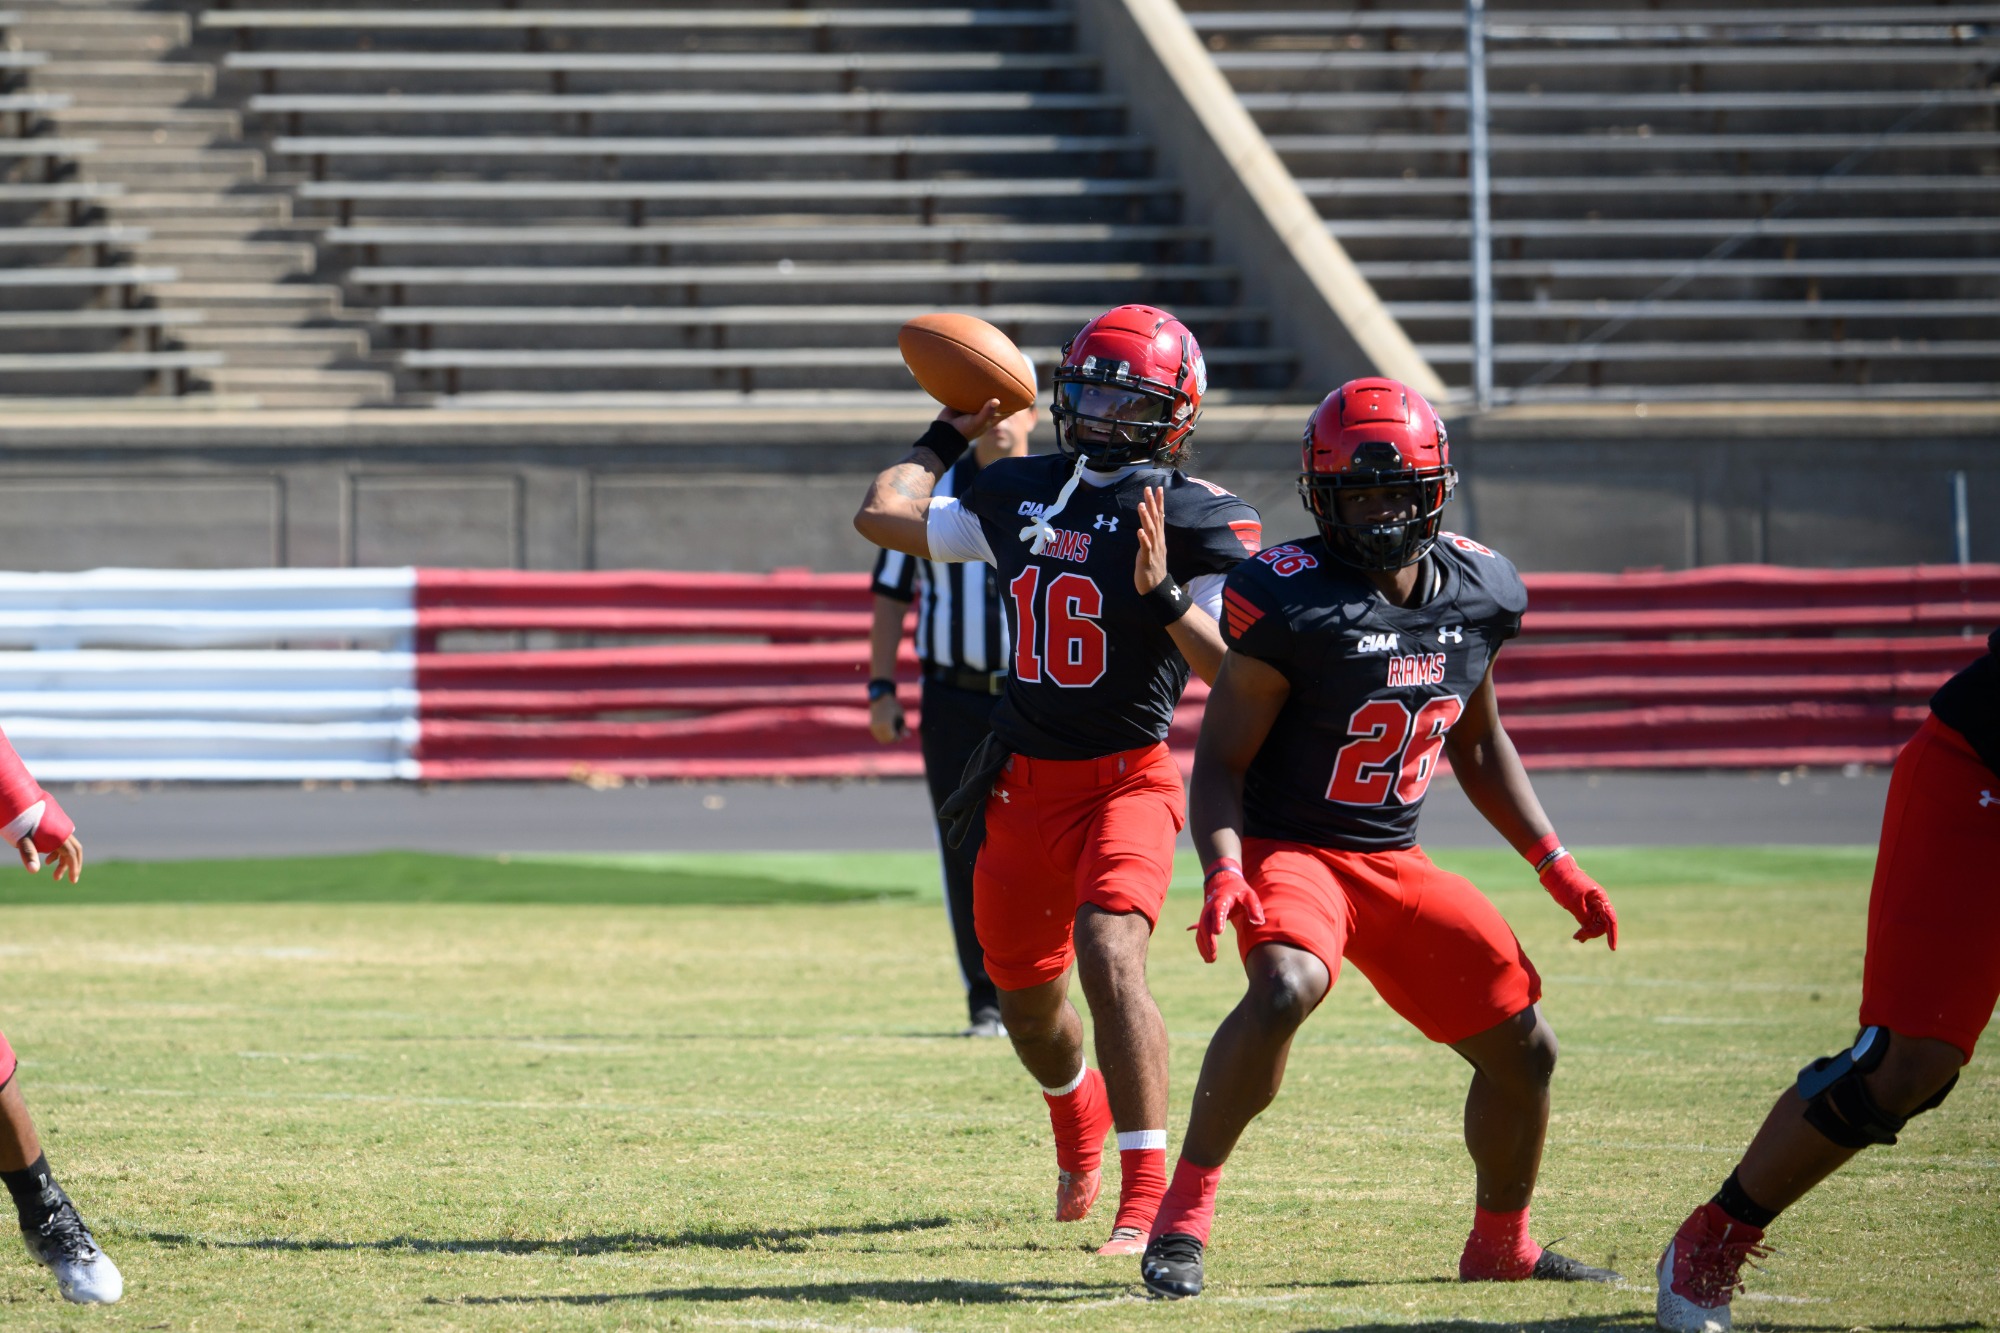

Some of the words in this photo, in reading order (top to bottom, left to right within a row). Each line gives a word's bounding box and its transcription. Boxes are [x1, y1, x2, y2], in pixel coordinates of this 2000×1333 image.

[1256, 544, 1319, 577] 26
[1010, 565, 1106, 688] 16
[1357, 633, 1399, 652] CIAA
[1387, 653, 1446, 687] RAMS
[1323, 695, 1464, 807] 26
